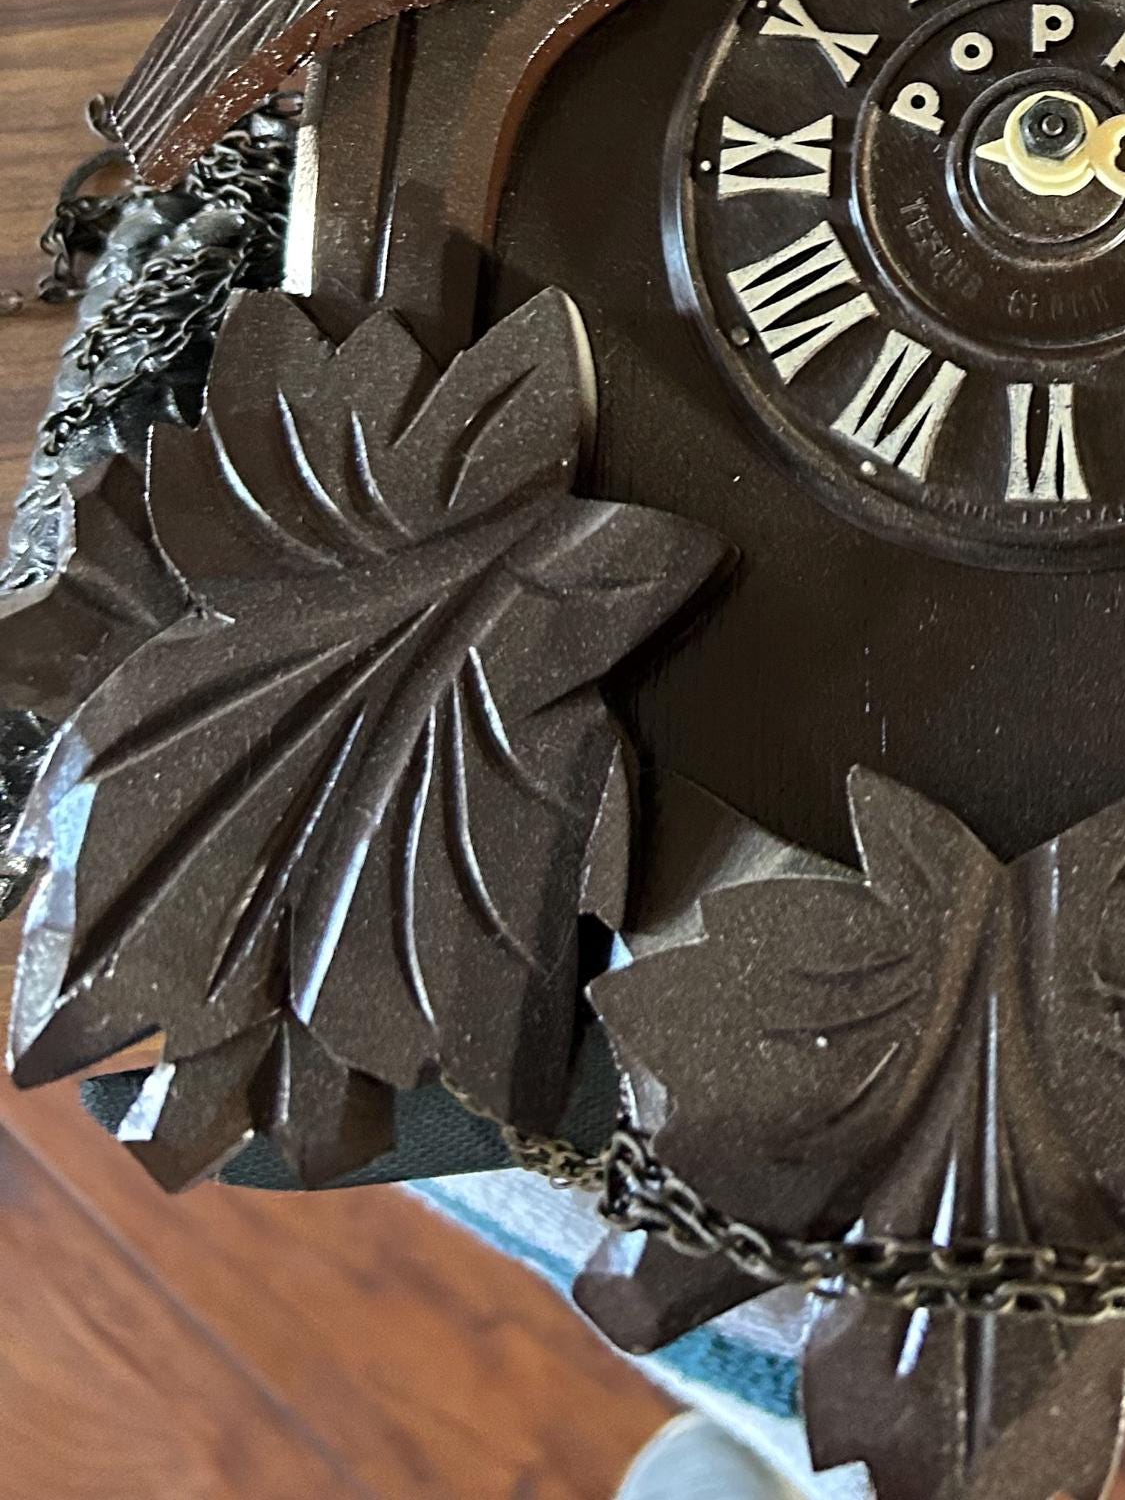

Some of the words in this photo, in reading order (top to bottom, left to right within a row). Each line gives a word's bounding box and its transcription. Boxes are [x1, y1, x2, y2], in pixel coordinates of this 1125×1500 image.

[717, 115, 833, 200] IX
[727, 221, 880, 385] VIII
[831, 329, 967, 484] VII
[1004, 383, 1092, 502] VI
